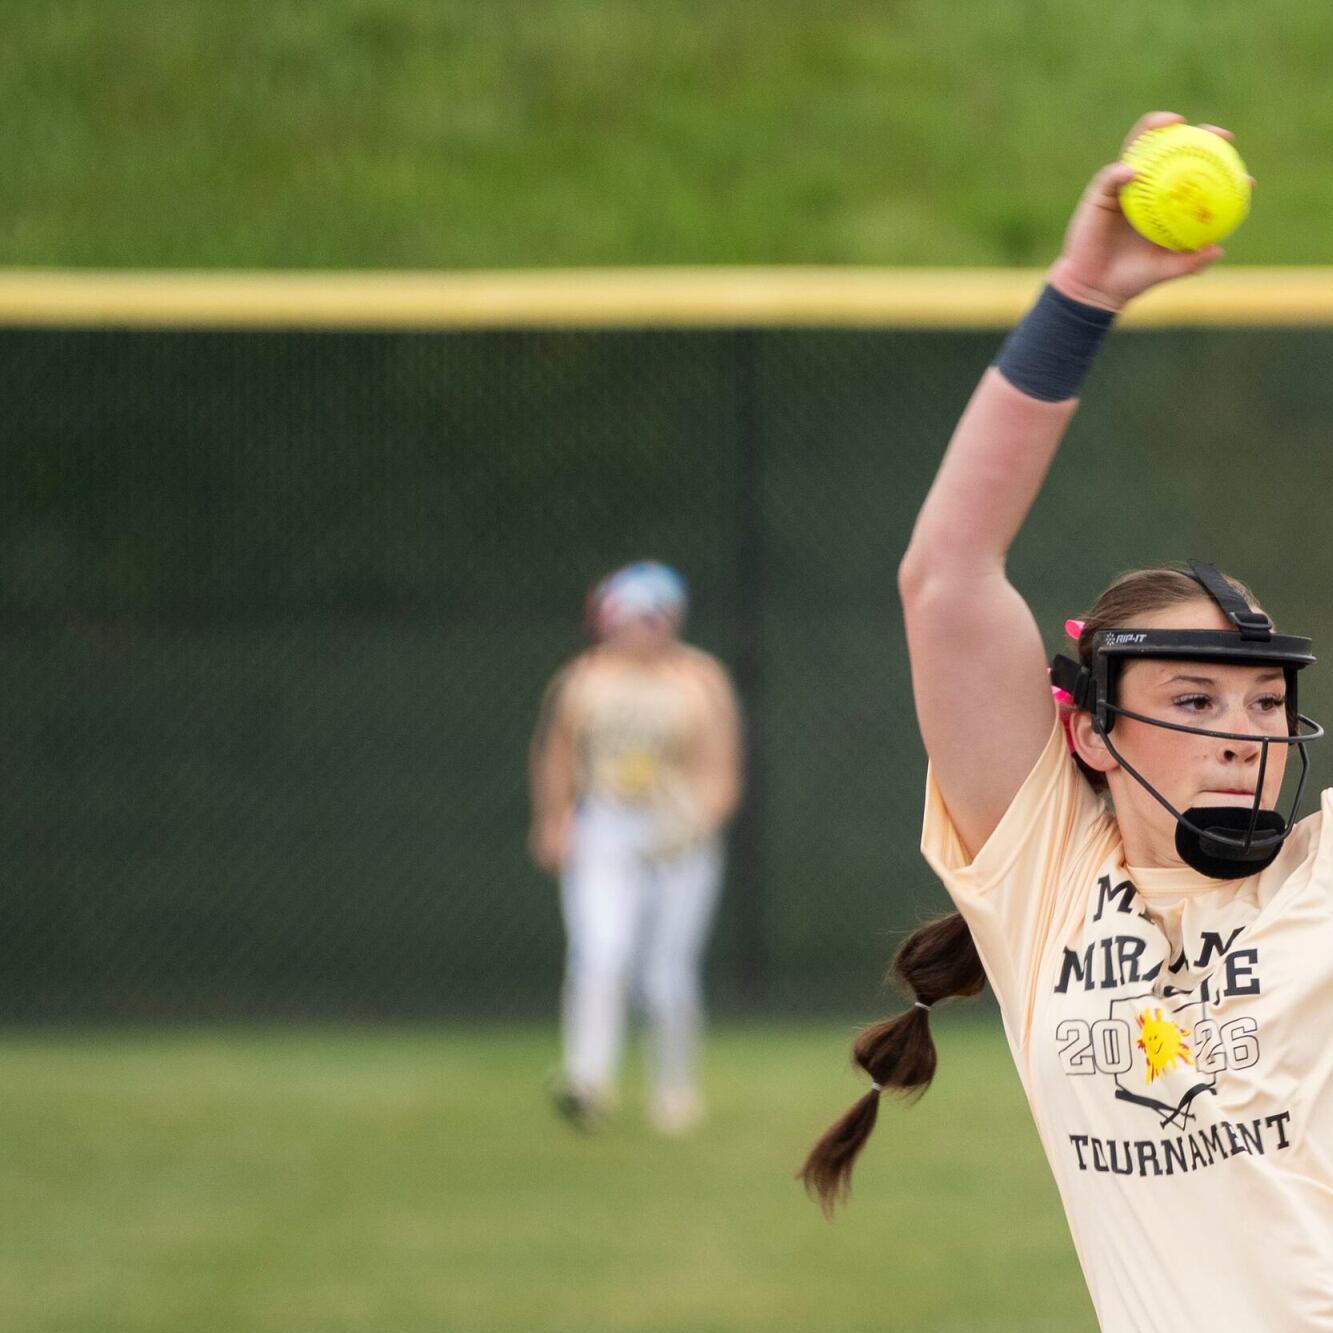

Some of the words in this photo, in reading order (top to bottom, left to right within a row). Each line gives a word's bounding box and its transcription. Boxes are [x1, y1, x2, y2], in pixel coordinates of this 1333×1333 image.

[1116, 633, 1147, 644] RIP-IT
[1056, 1018, 1133, 1076] 20
[1069, 1110, 1292, 1177] TOURNAMENT
